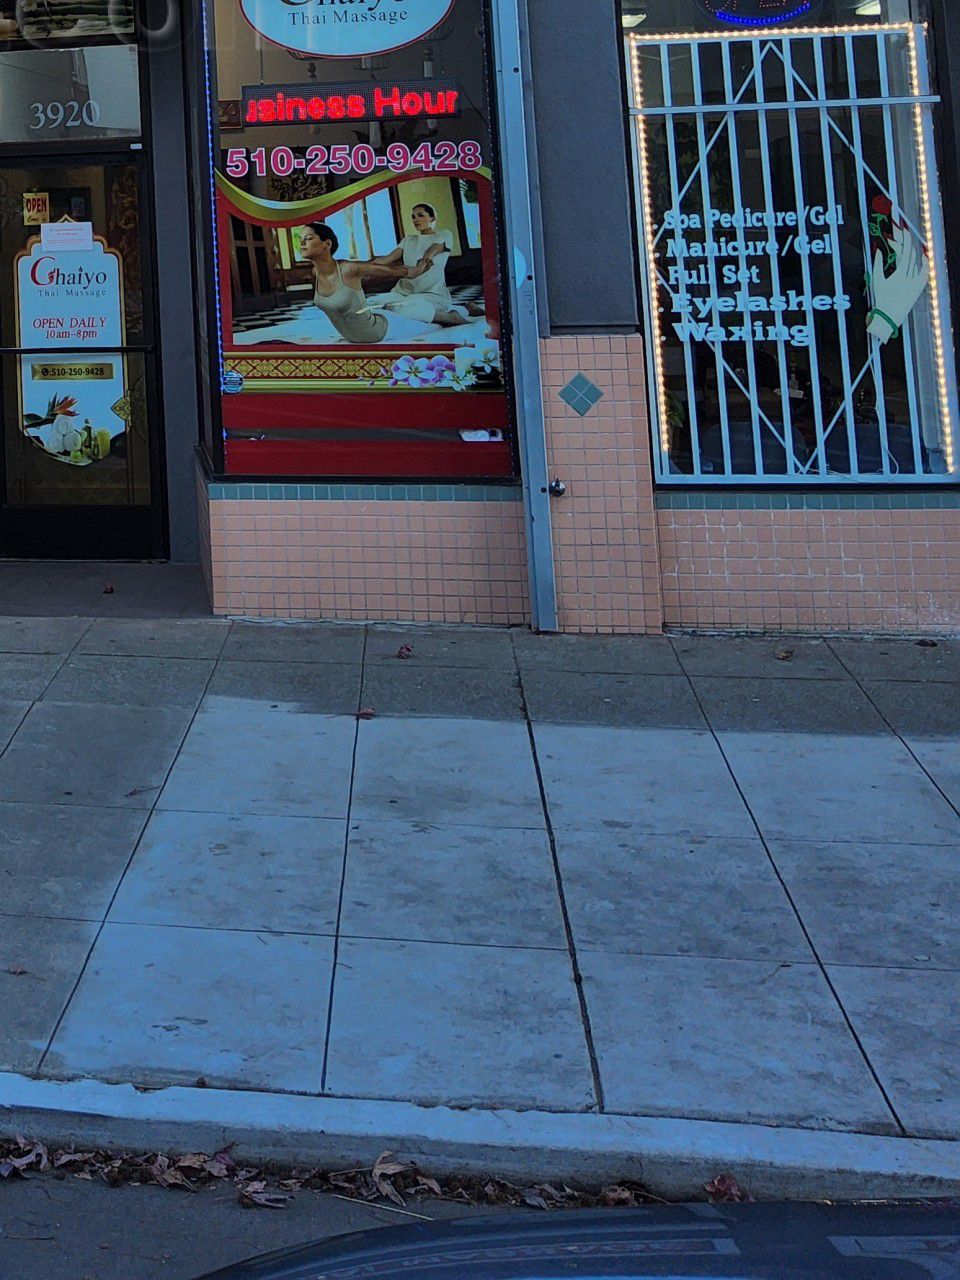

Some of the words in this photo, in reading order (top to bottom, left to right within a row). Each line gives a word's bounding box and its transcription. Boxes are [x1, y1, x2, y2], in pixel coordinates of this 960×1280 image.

[288, 10, 327, 26] Thai
[333, 9, 409, 25] Massage
[29, 100, 100, 129] 3920
[373, 86, 459, 117] Hour
[226, 141, 482, 177] 510-250-9428
[26, 198, 47, 214] OPEN
[30, 256, 107, 289] Chaiyo
[723, 264, 760, 284] Set
[66, 289, 107, 298] Massage
[671, 290, 851, 318] Eyelashes
[33, 318, 64, 329] OPEN
[70, 316, 107, 328] DAILY
[672, 321, 811, 347] Waxing
